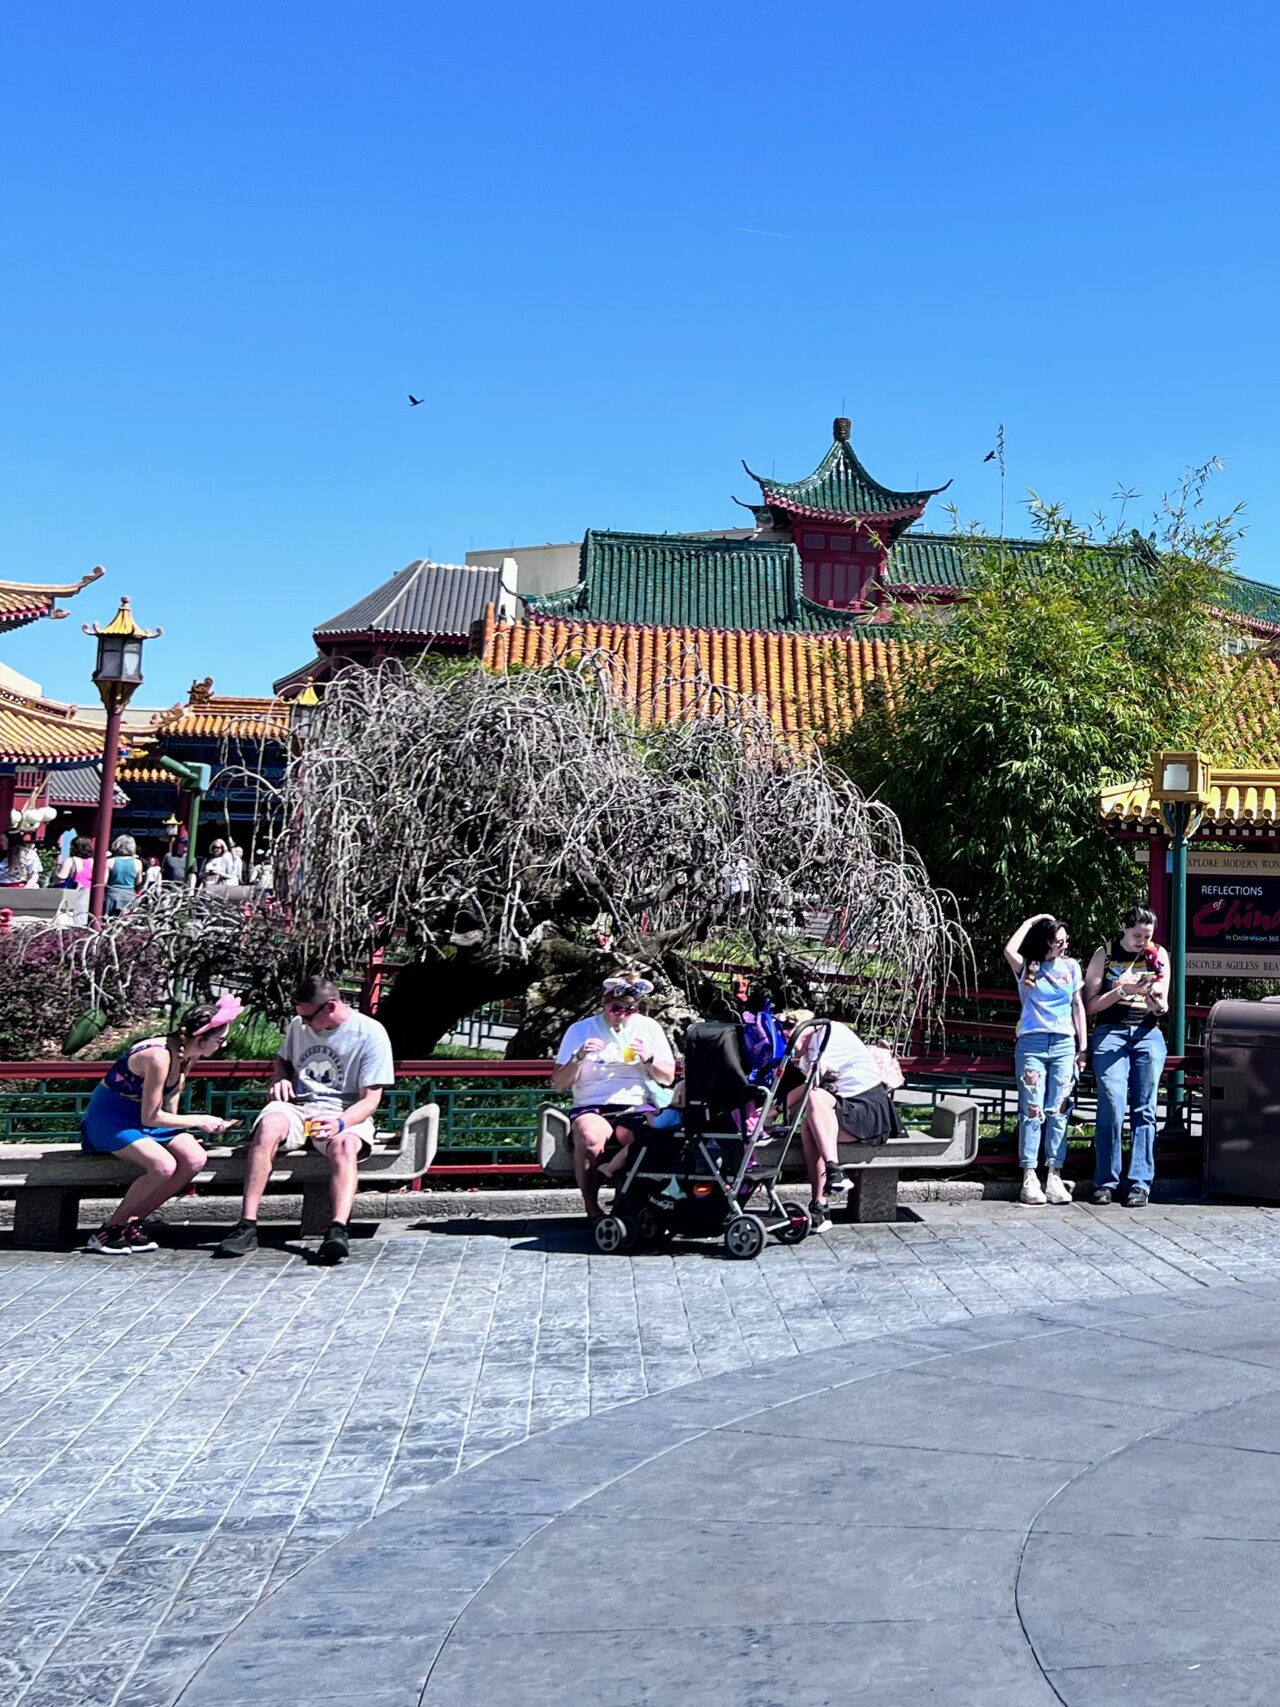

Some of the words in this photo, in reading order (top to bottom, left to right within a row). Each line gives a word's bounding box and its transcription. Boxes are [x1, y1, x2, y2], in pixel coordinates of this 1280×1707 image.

[1187, 858, 1219, 868] XPLORE
[1222, 859, 1258, 868] MODERN
[1201, 885, 1263, 895] REFLECTIONS
[1213, 899, 1224, 911] of
[1224, 960, 1259, 970] AGELESS
